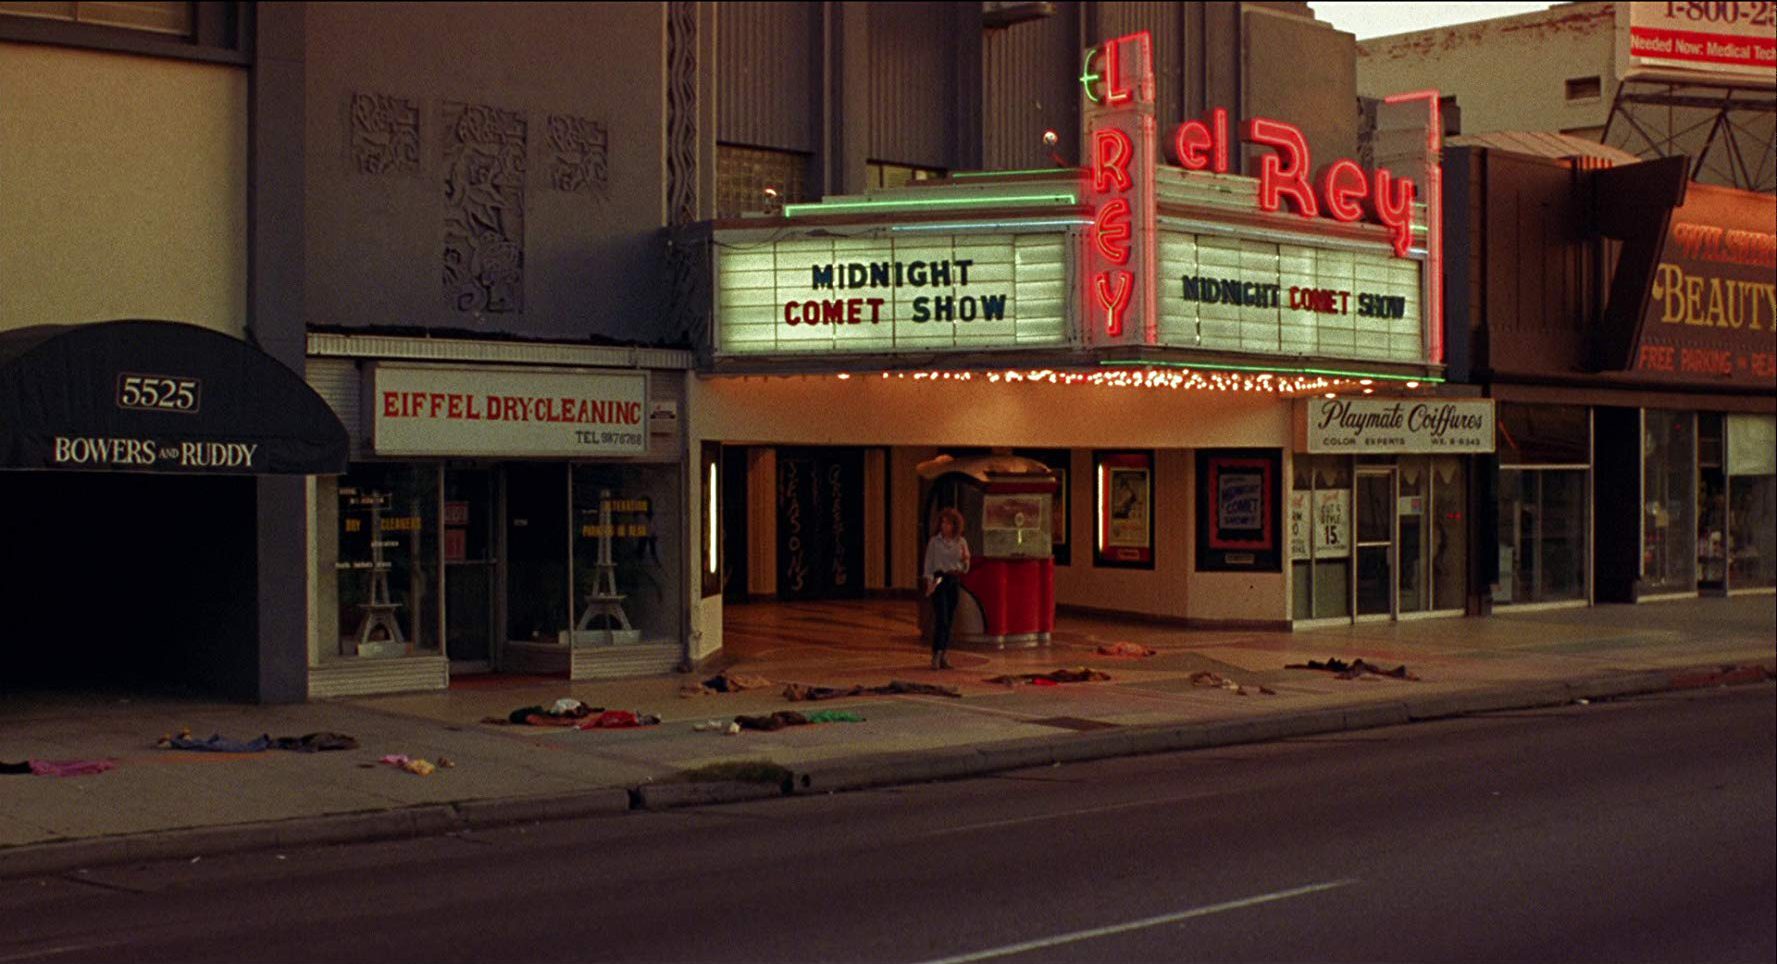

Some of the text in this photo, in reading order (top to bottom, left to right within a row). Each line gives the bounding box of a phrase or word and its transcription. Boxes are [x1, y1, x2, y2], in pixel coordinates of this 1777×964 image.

[1631, 34, 1672, 53] Needed
[1675, 38, 1704, 56] Now:
[1707, 41, 1750, 59] Medical
[1174, 106, 1415, 258] el Rey
[1093, 127, 1134, 338] REY
[812, 259, 973, 290] MIDNIGHT
[784, 294, 1007, 326] COMET SHOW
[1182, 275, 1406, 320] MIDNIGHT COMET SHOW
[1638, 344, 1675, 372] FREE
[1681, 347, 1733, 374] PARKING
[122, 377, 196, 409] 5525
[383, 391, 482, 420] EIFFEL
[1318, 400, 1483, 438] Playmate Coiffures
[55, 436, 257, 467] BOWERS AND RUDDY
[576, 431, 599, 444] TEL
[1323, 437, 1356, 447] COLOR
[1364, 437, 1405, 447] EXPERTS
